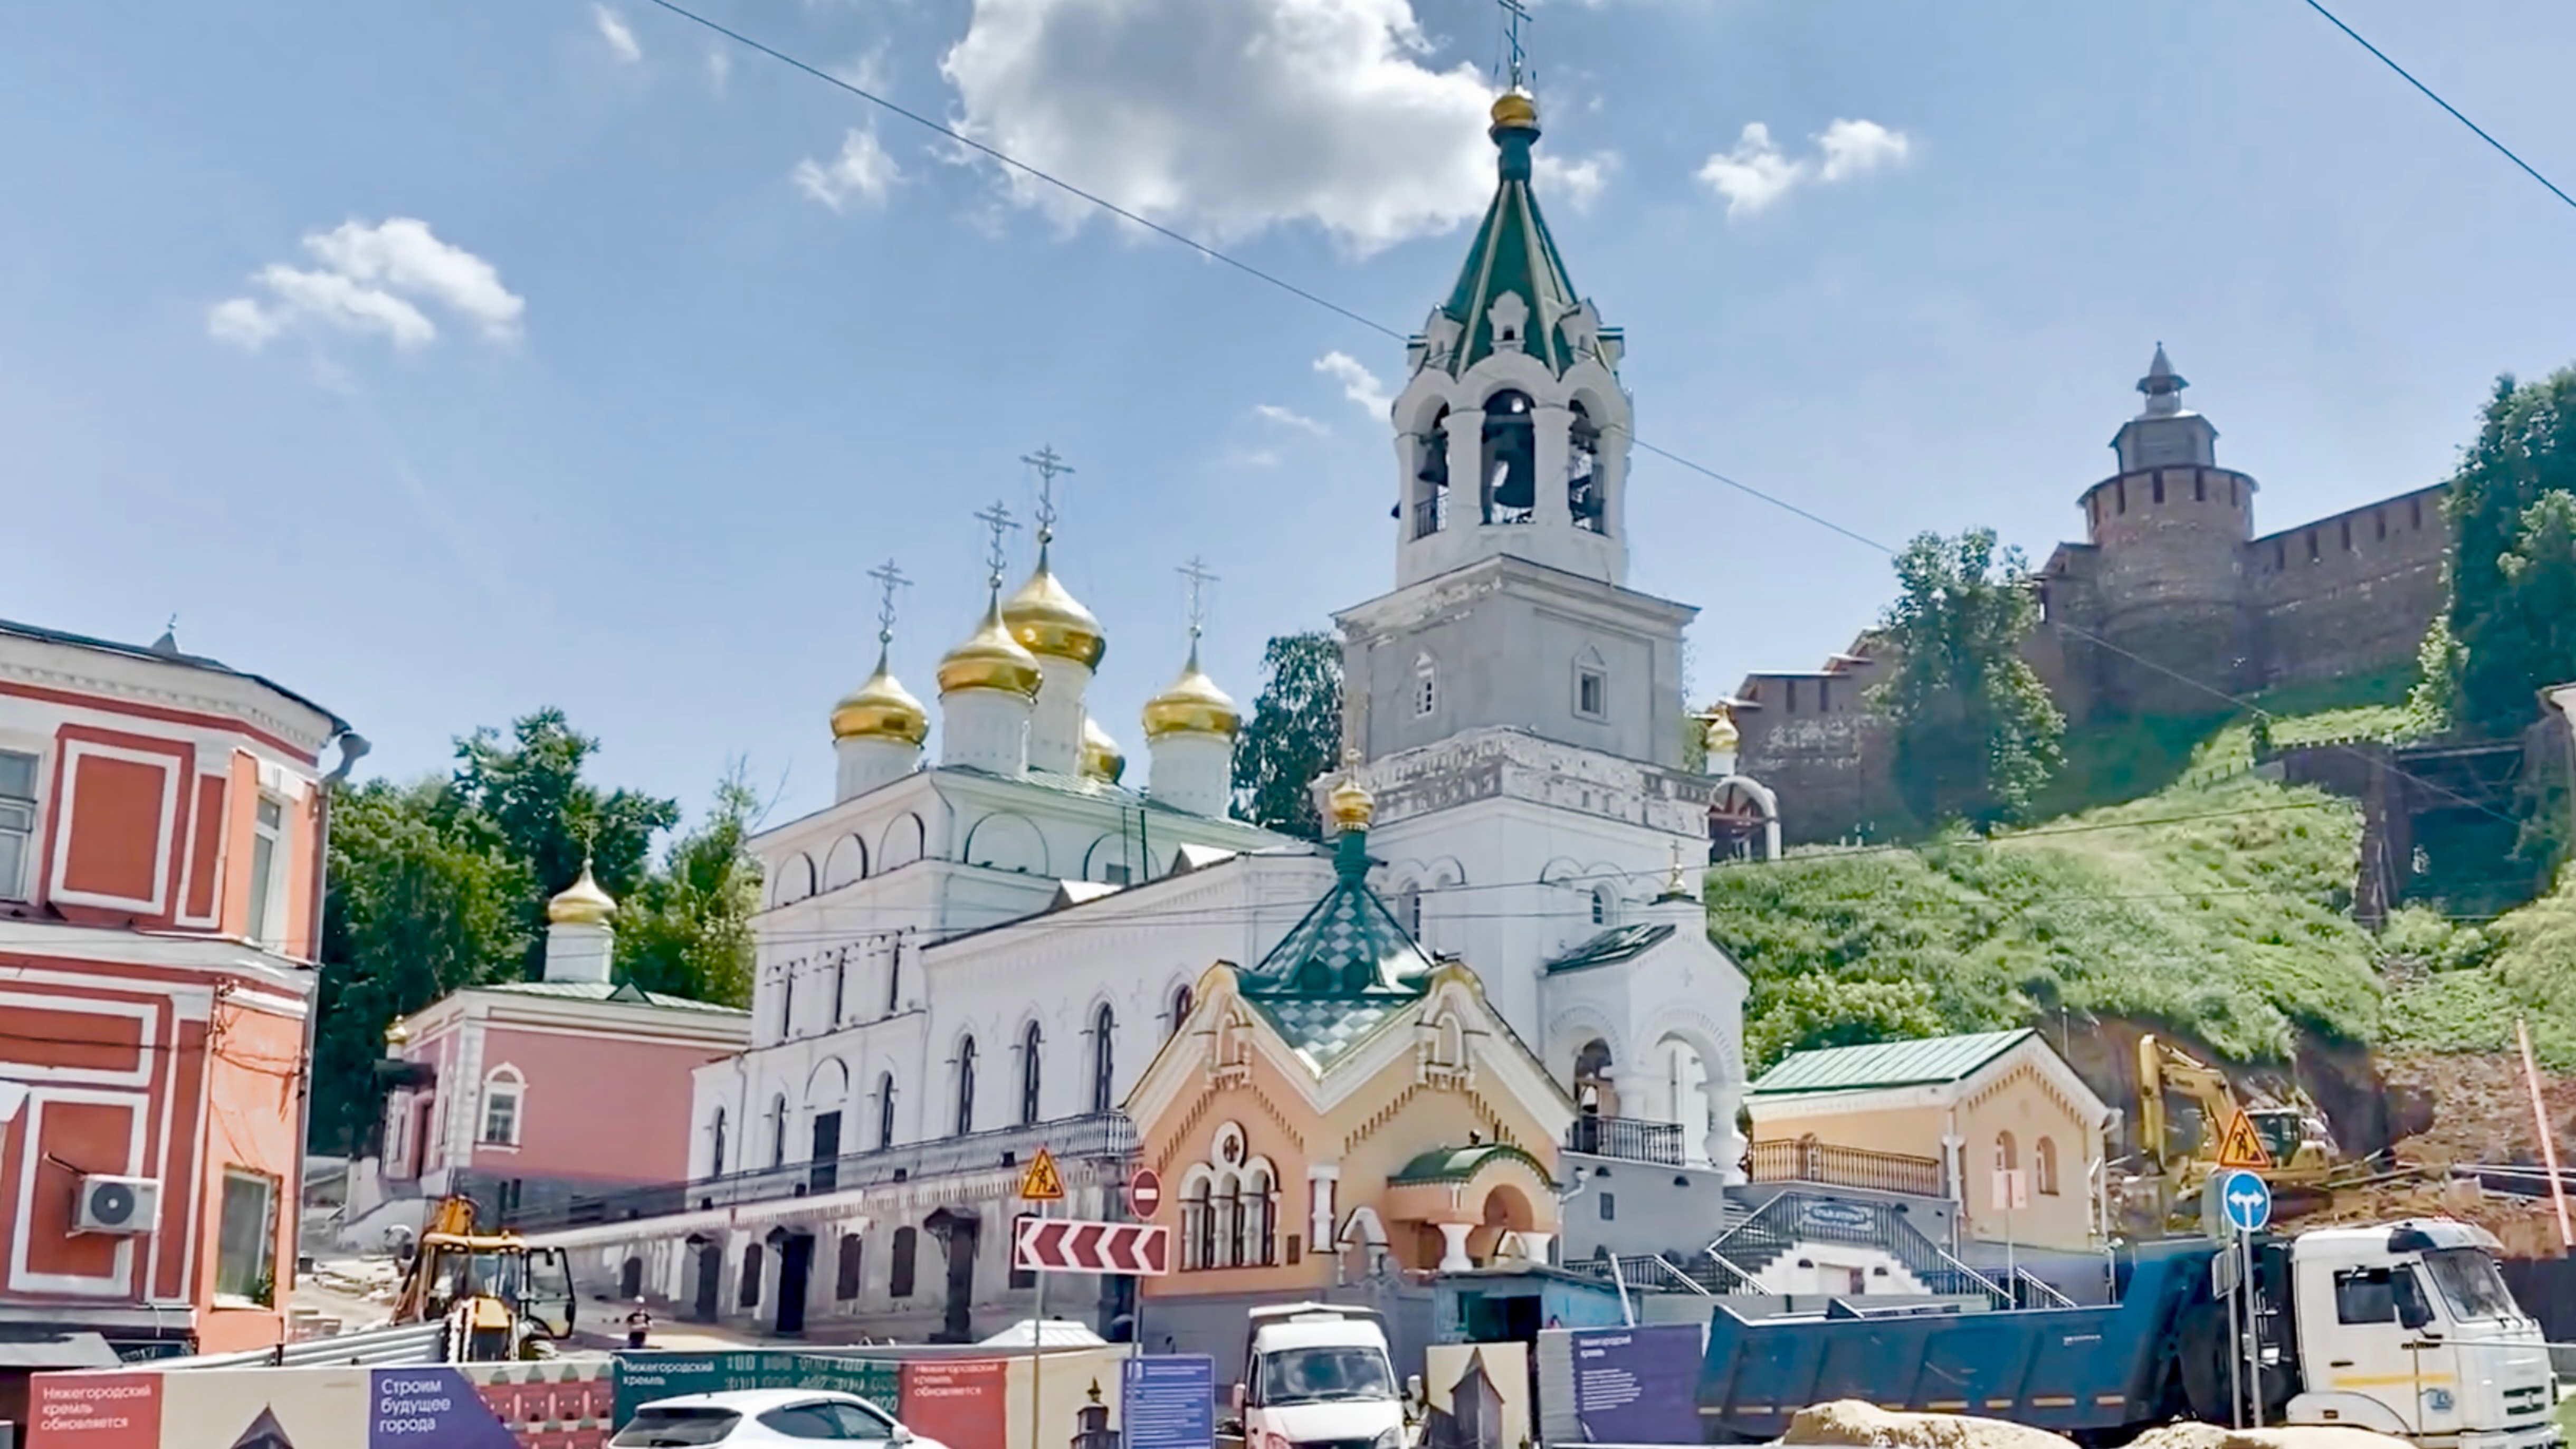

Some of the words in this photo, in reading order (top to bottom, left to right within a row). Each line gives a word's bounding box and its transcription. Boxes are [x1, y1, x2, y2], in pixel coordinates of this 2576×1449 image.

[623, 1361, 714, 1374] Нижегородский
[381, 1378, 442, 1396] Строим
[623, 1376, 665, 1386] кремль
[43, 1384, 151, 1400] Нижегородский
[42, 1403, 93, 1416] кремль
[380, 1397, 451, 1415] будущее
[41, 1416, 128, 1431] обновляется
[379, 1418, 436, 1435] города
